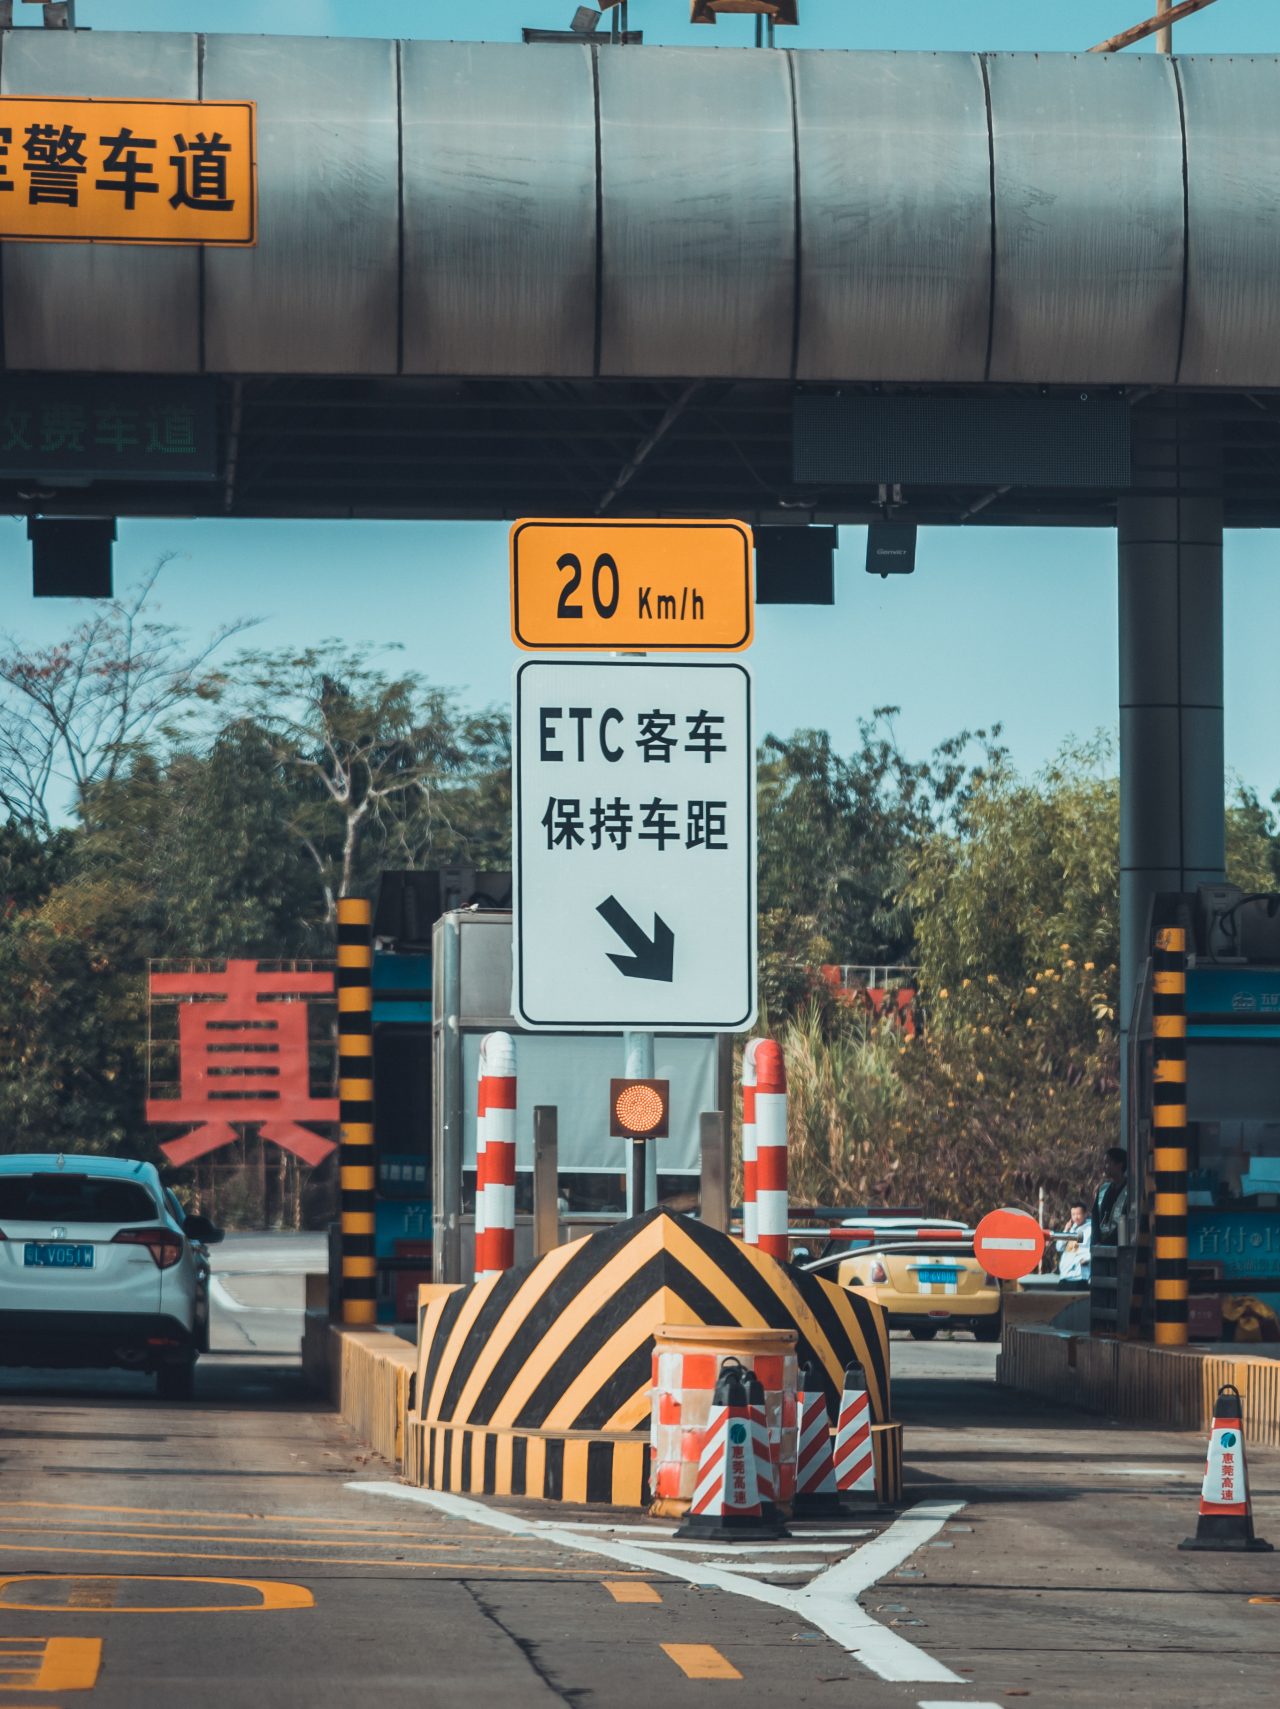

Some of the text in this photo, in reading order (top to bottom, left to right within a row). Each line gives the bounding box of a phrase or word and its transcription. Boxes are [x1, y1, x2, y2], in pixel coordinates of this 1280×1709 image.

[0, 122, 236, 212] 警车道
[555, 552, 706, 621] 20 Km/h
[538, 706, 729, 764] ETC客车
[540, 795, 730, 852] 保持车距
[146, 959, 341, 1168] 真
[1221, 1452, 1235, 1501] 惠莞高速
